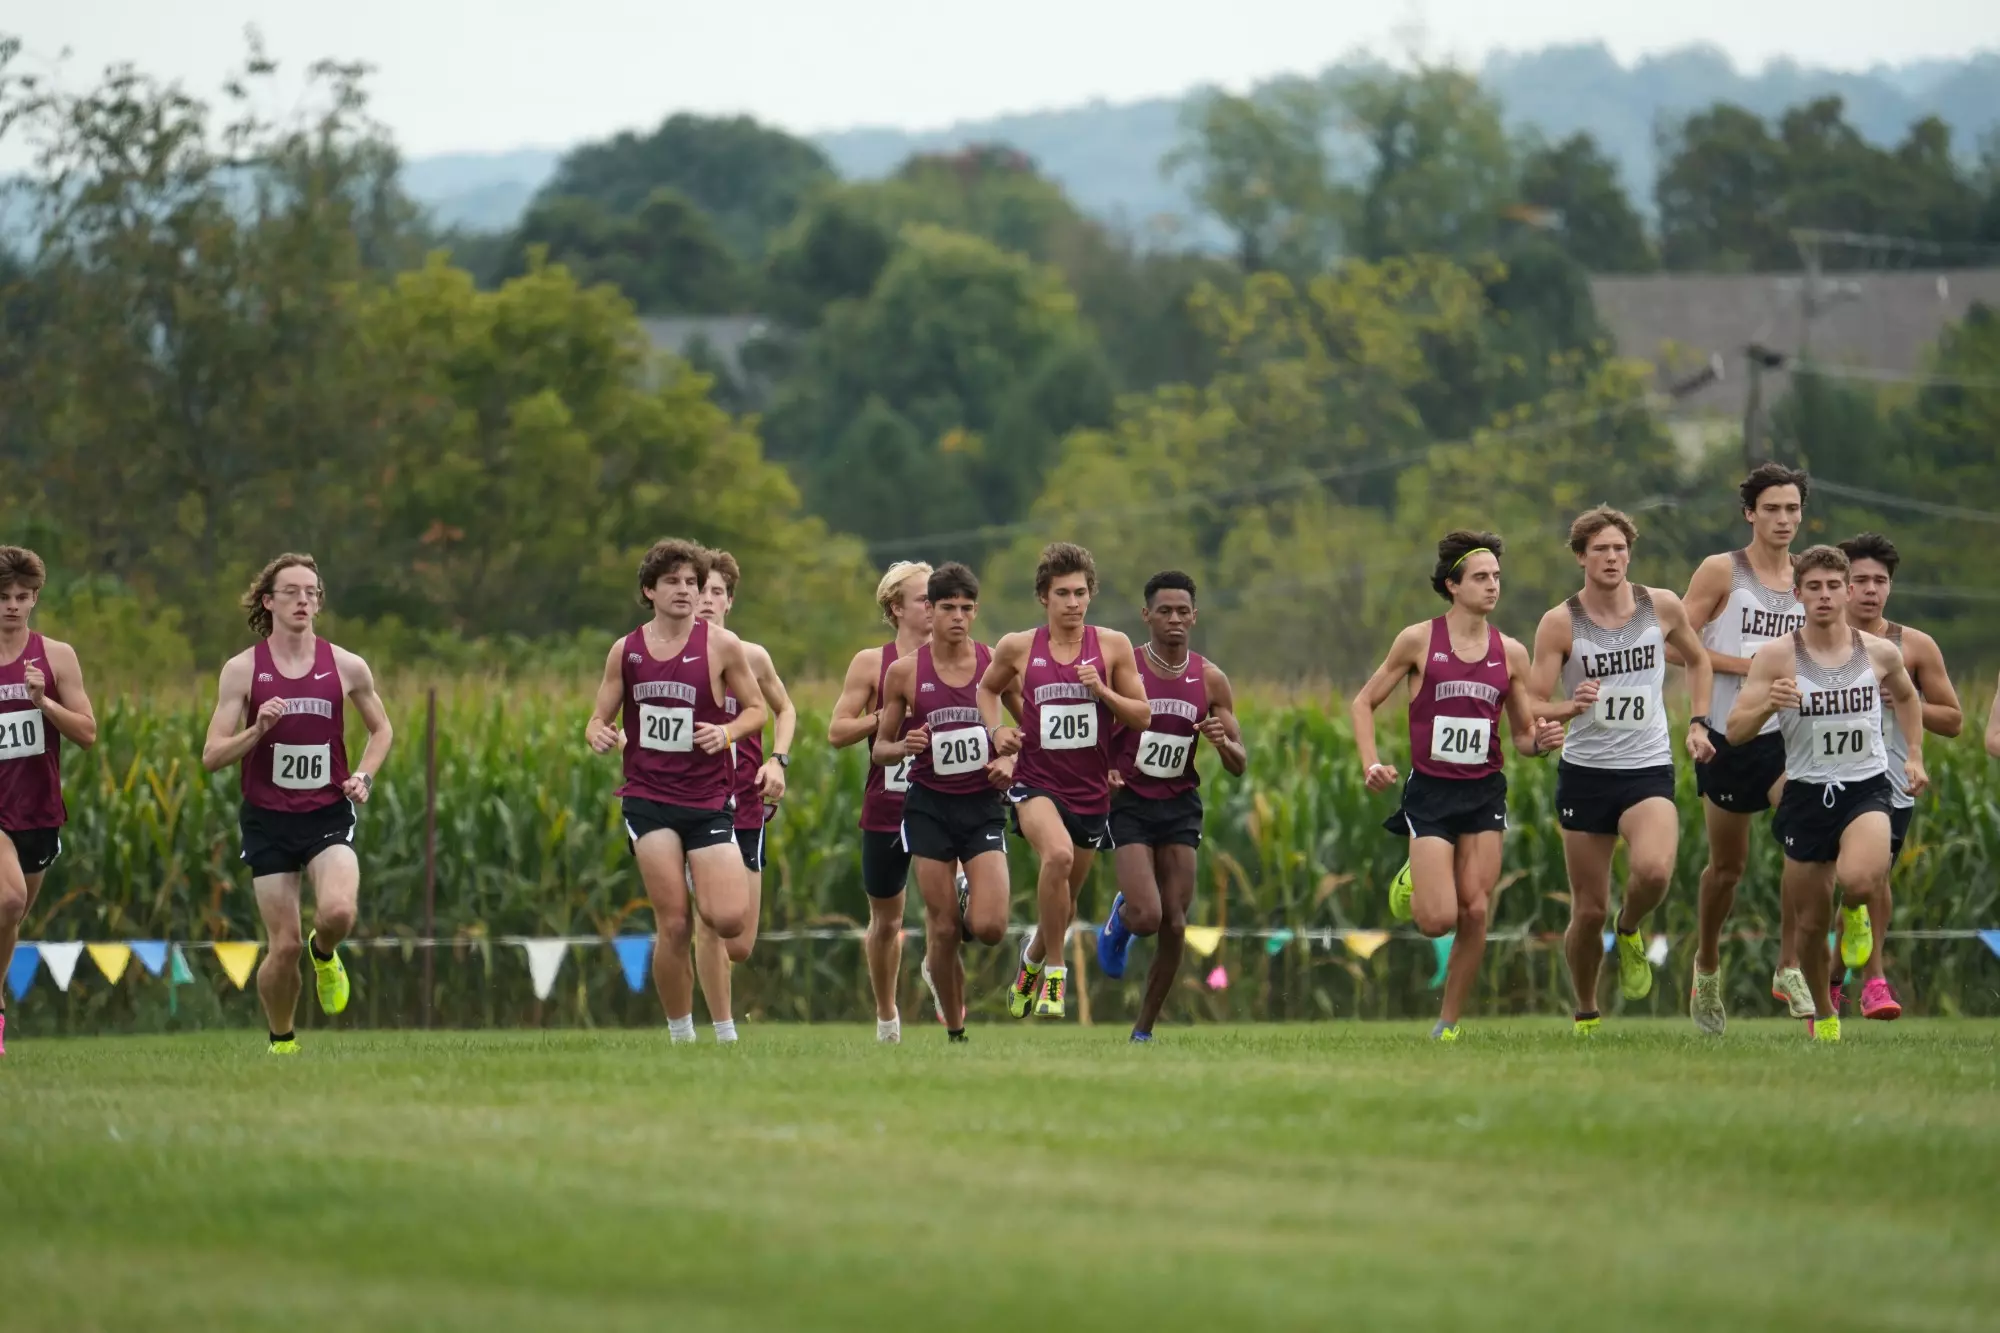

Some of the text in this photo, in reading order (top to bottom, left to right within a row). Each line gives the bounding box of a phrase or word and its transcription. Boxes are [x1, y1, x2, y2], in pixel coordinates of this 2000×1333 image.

[1742, 607, 1806, 638] LEHIGH
[1581, 644, 1656, 678] LEHIGH
[1605, 696, 1645, 721] 178
[1799, 685, 1874, 717] LEHIGH
[0, 720, 36, 750] 210
[646, 715, 684, 742] 207
[1049, 714, 1090, 740] 205
[1440, 727, 1482, 754] 204
[940, 737, 981, 765] 203
[1143, 742, 1185, 769] 208
[1823, 729, 1863, 756] 170
[281, 754, 323, 780] 206
